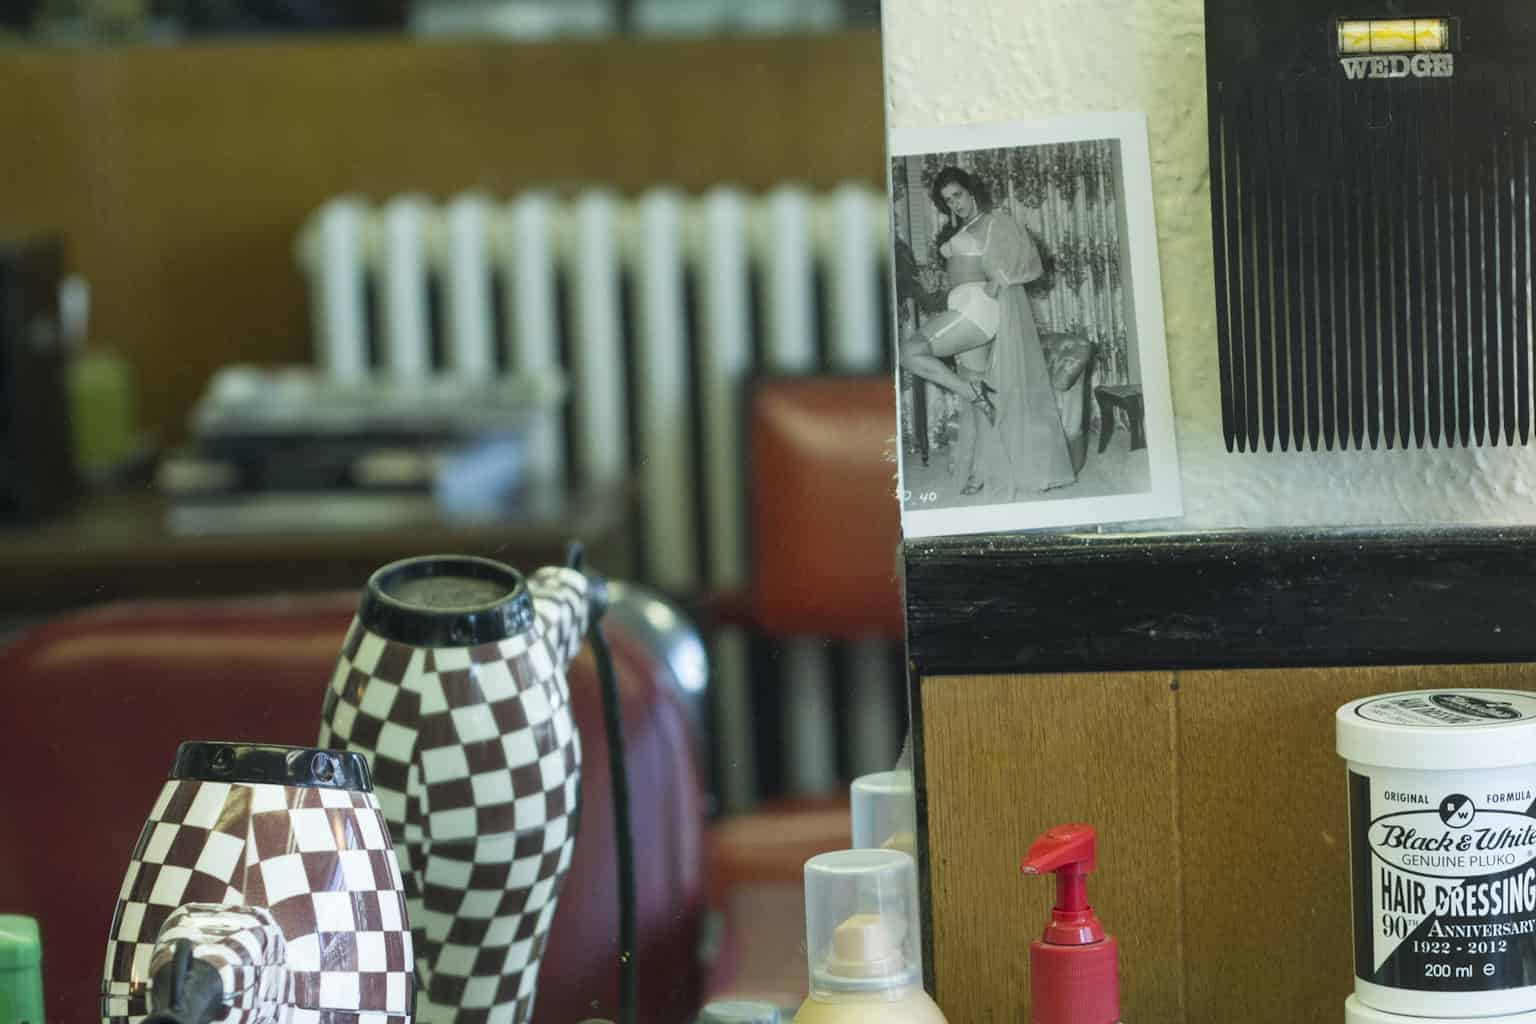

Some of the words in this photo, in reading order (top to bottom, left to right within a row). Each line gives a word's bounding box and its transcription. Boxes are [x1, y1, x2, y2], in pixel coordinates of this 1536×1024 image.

[1340, 53, 1453, 80] WEDGE
[1384, 791, 1429, 804] ORIGINAL
[1487, 791, 1531, 804] FORMULA
[1378, 824, 1451, 851] Black
[1402, 854, 1464, 867] GENUINE
[1470, 853, 1515, 866] PLUKO
[1381, 867, 1426, 915] HAIR
[1435, 867, 1536, 916] DRESSING
[1413, 940, 1450, 953] 1922
[1468, 940, 1506, 953] 2012
[1425, 964, 1450, 977] 200
[1456, 965, 1472, 977] ml
